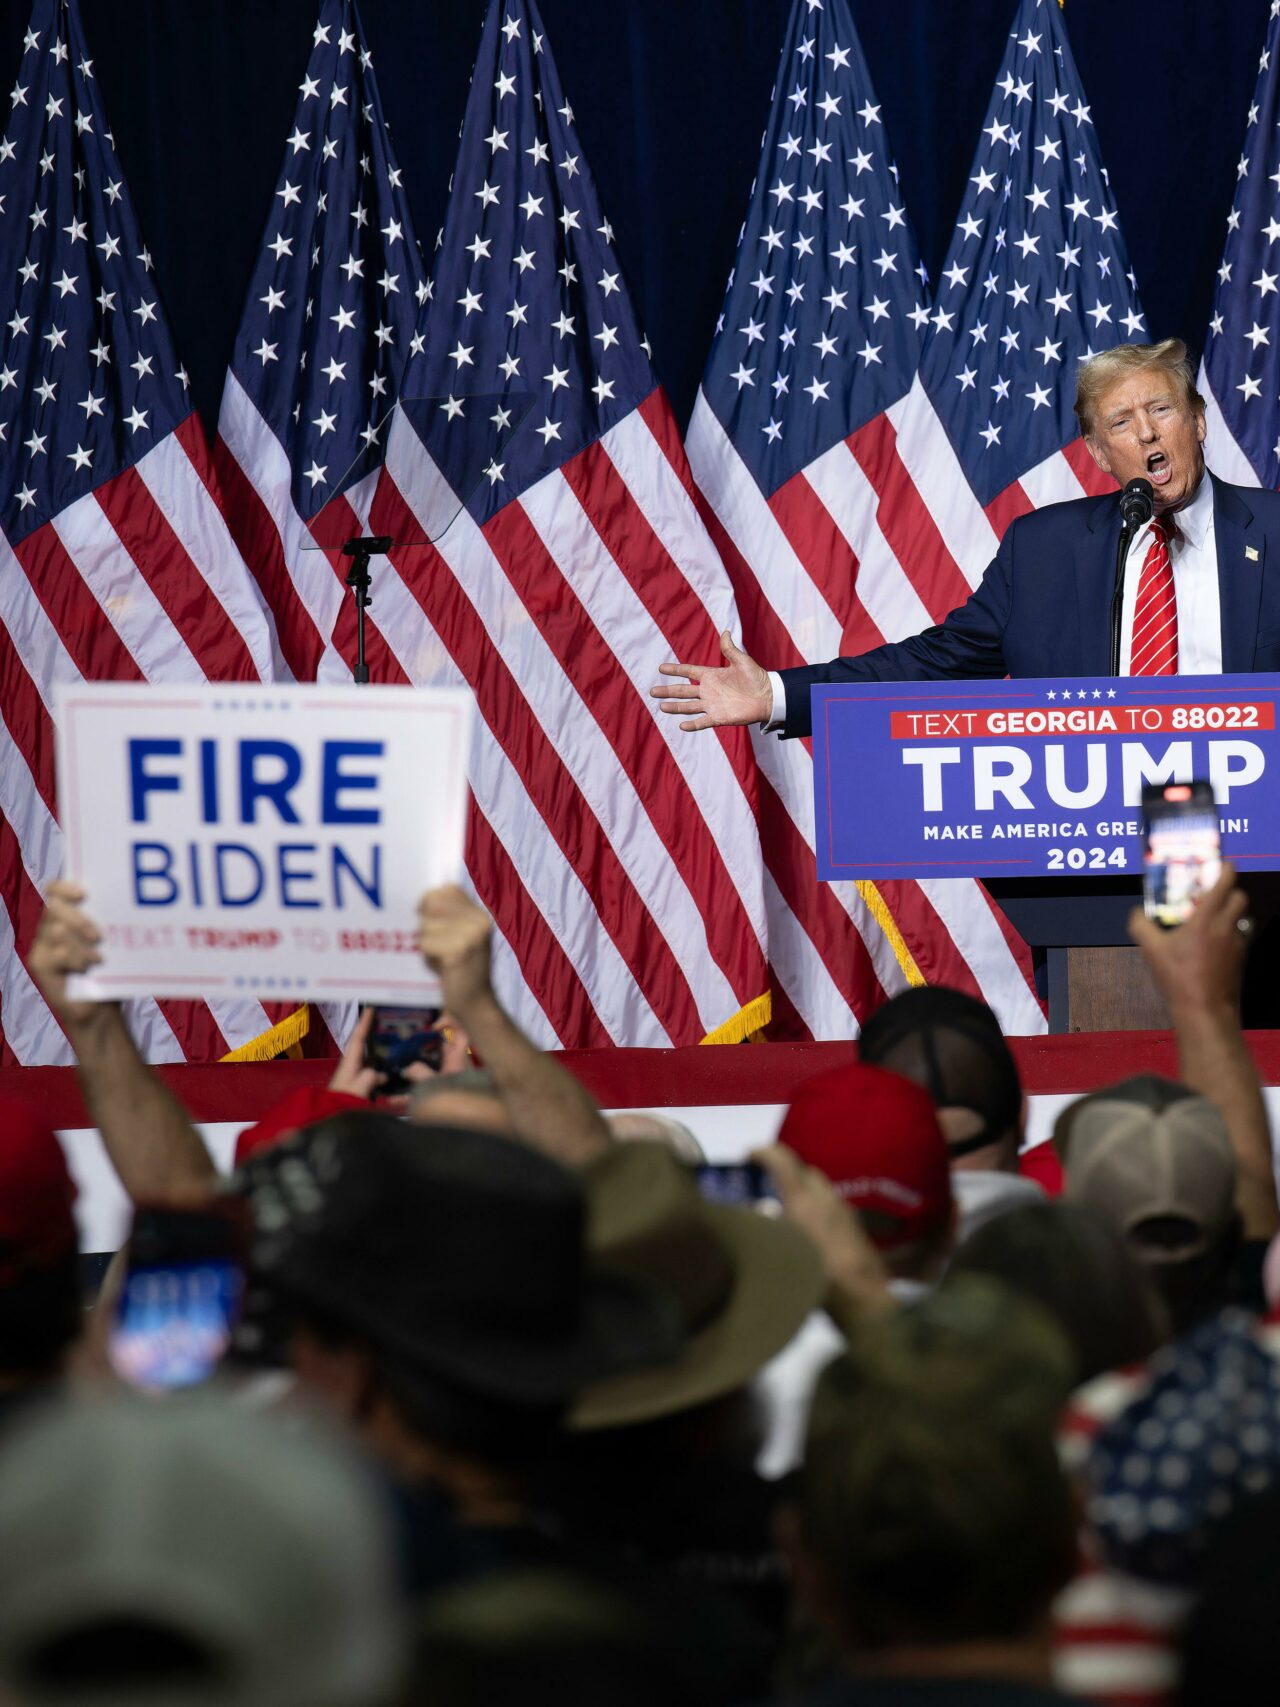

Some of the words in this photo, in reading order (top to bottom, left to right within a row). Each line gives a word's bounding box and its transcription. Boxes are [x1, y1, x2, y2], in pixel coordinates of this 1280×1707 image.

[907, 714, 977, 735] TEXT
[987, 709, 1117, 733] GEORGIA
[1125, 708, 1162, 730] TO
[1172, 706, 1258, 729] 88022
[127, 738, 386, 826] FIRE
[903, 740, 1265, 811] TRUMP
[924, 825, 983, 840] MAKE
[992, 822, 1088, 838] AMERICA
[1097, 820, 1145, 837] GRE
[1219, 819, 1249, 833] IN!
[1047, 847, 1127, 869] 2024
[131, 841, 384, 909] BIDEN
[184, 926, 282, 950] TRUMP
